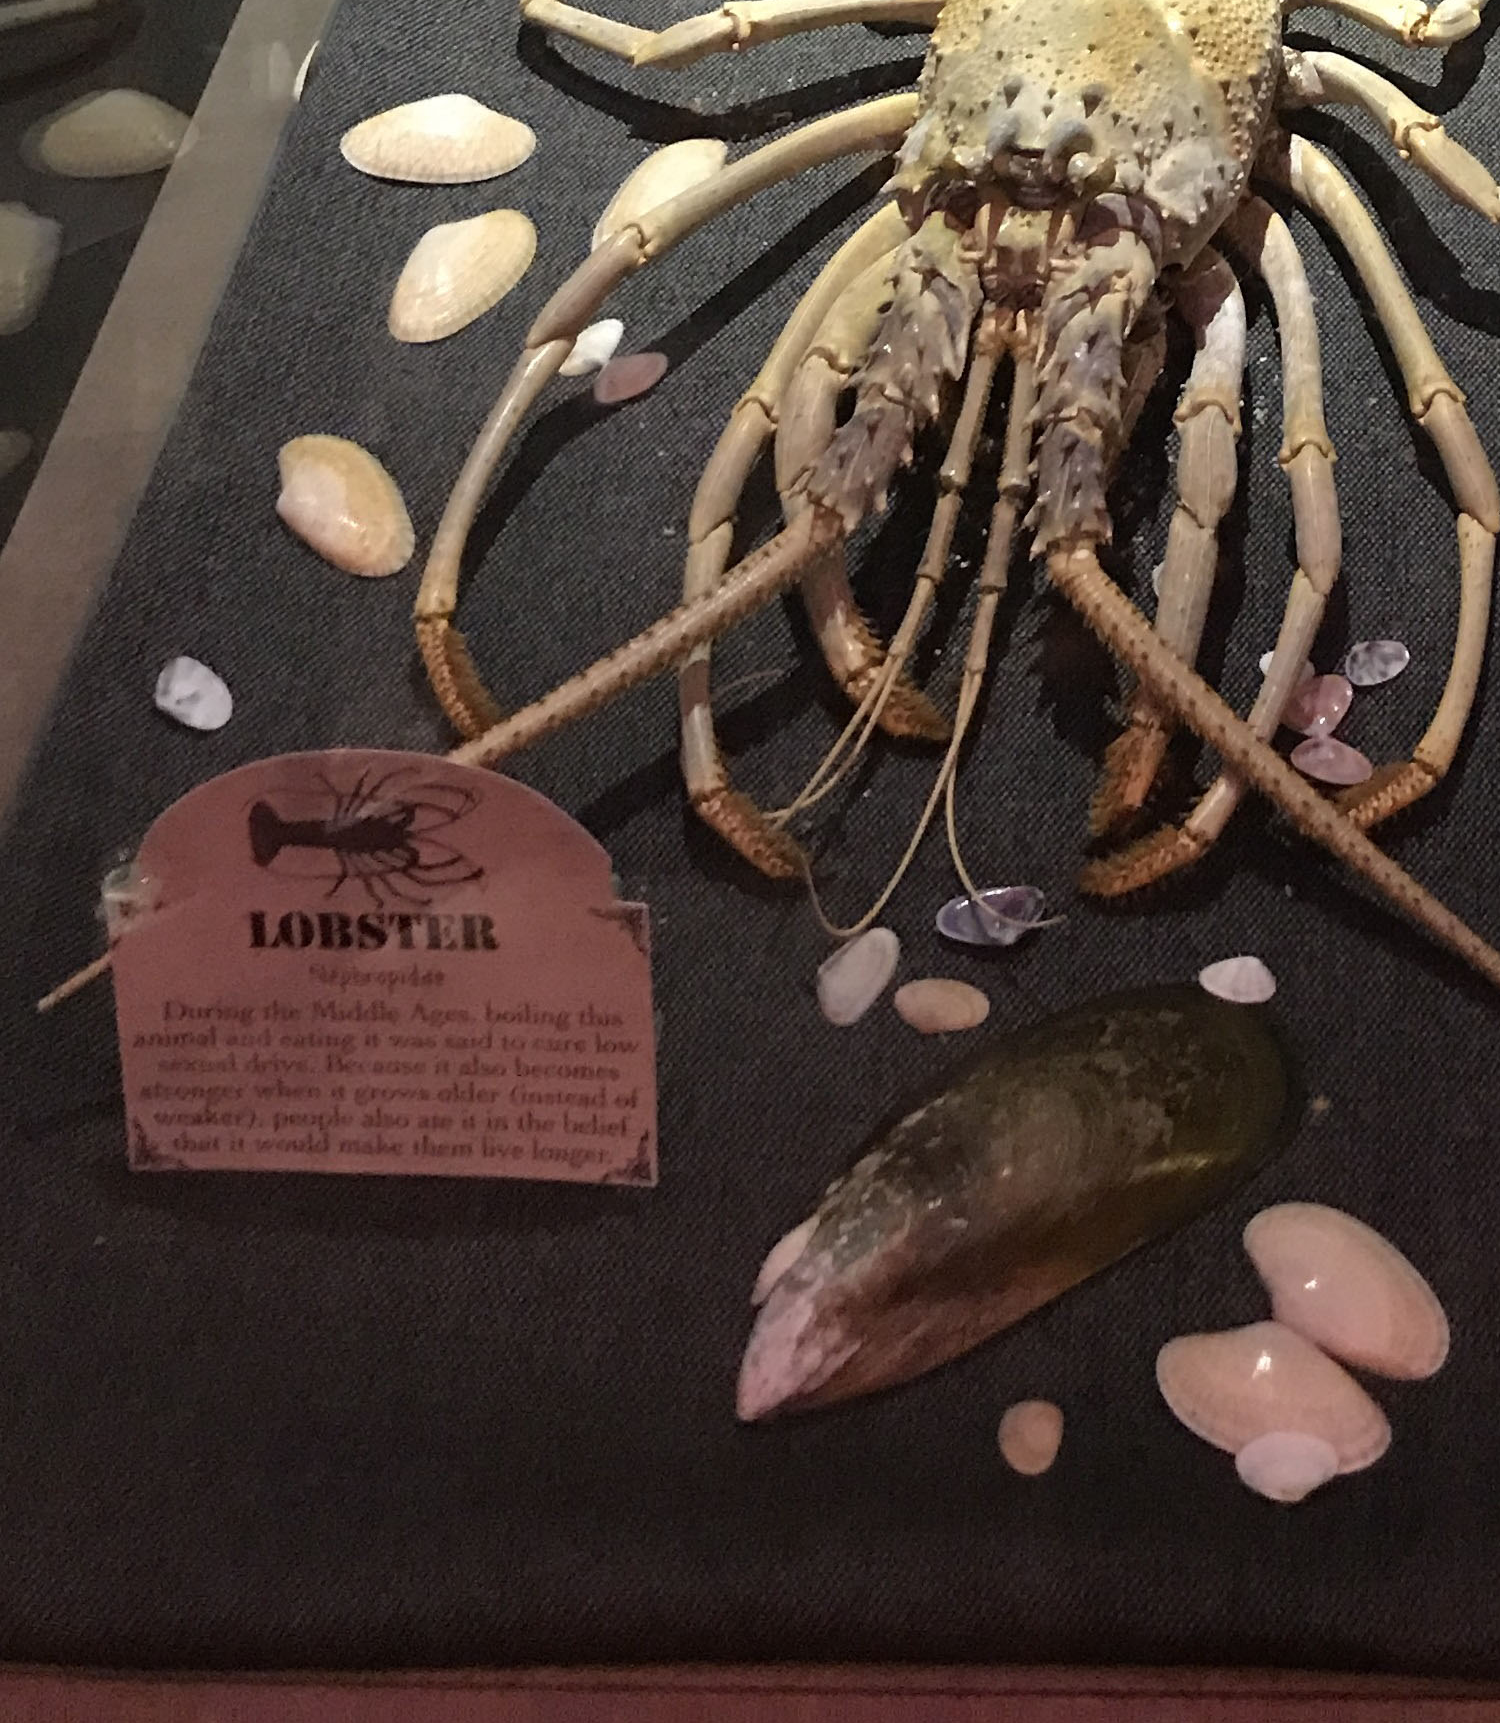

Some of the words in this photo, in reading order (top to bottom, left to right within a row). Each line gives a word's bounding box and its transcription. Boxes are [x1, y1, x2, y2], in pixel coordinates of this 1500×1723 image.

[249, 912, 500, 952] LOBSTER
[163, 1001, 255, 1027] During
[264, 1003, 304, 1022] the
[313, 1003, 399, 1024] Middle
[486, 1003, 569, 1030] boiling
[579, 1005, 624, 1027] this
[134, 1028, 217, 1049] animal
[225, 1028, 272, 1047] and
[280, 1030, 354, 1056] eating
[365, 1030, 381, 1048] it
[390, 1035, 437, 1050] was
[445, 1030, 494, 1051] said
[502, 1034, 526, 1051] to
[532, 1038, 585, 1054] cure
[596, 1028, 639, 1054] low
[326, 1055, 425, 1075] Because
[435, 1056, 452, 1075] it
[460, 1055, 507, 1076] also
[515, 1057, 619, 1080] becomes
[140, 1081, 243, 1109] stronger
[255, 1078, 320, 1100] when
[331, 1085, 346, 1101] it
[355, 1086, 430, 1108] grows
[438, 1083, 500, 1104] older
[615, 1089, 638, 1109] of
[273, 1106, 353, 1135] people
[361, 1107, 409, 1131] also
[461, 1112, 476, 1132] it
[519, 1112, 557, 1133] the
[565, 1112, 629, 1138] belief
[173, 1133, 219, 1154] that
[230, 1136, 245, 1154] it
[255, 1133, 330, 1156] would
[339, 1137, 404, 1156] make
[414, 1137, 473, 1157] them
[482, 1138, 527, 1159] live
